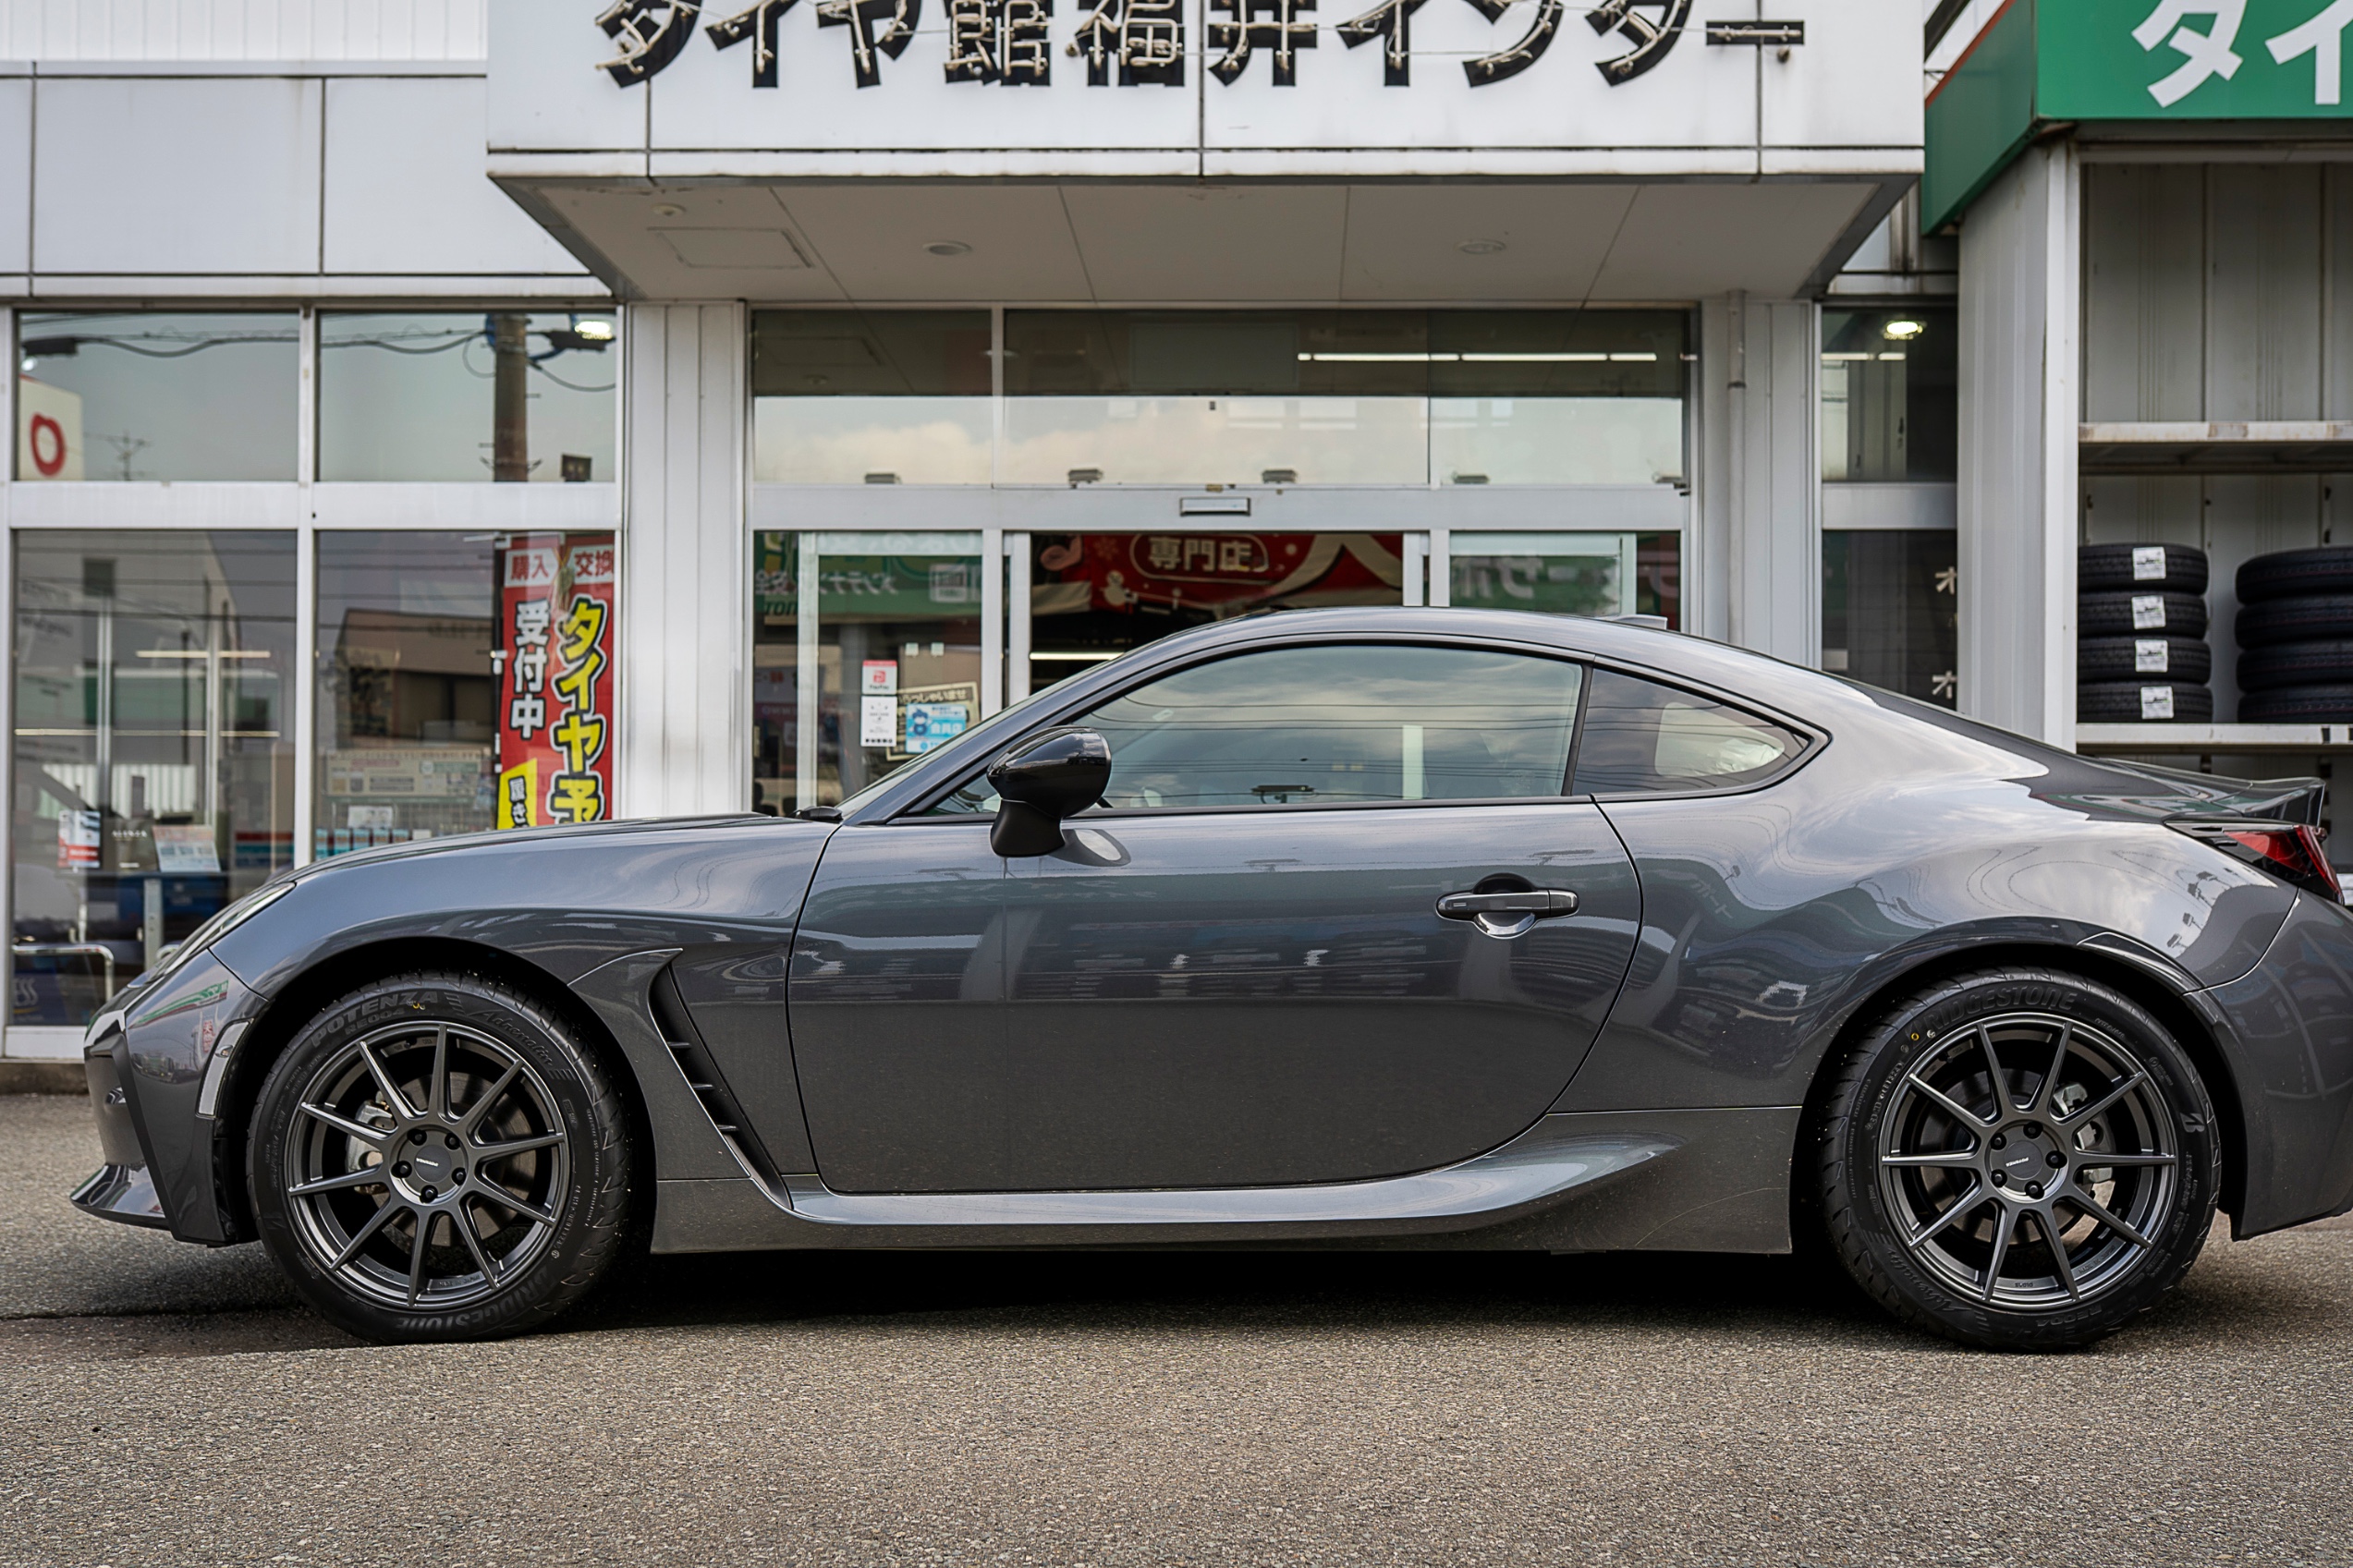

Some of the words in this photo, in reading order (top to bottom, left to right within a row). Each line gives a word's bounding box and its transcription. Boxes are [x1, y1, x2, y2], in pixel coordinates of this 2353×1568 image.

[2131, 0, 2353, 107] タイ
[1149, 536, 1255, 572] 専門店
[510, 600, 550, 740] 受付中
[311, 991, 438, 1048] POTENZA
[345, 1007, 406, 1036] RE004
[1904, 985, 2079, 1050] BRIDGESTONE
